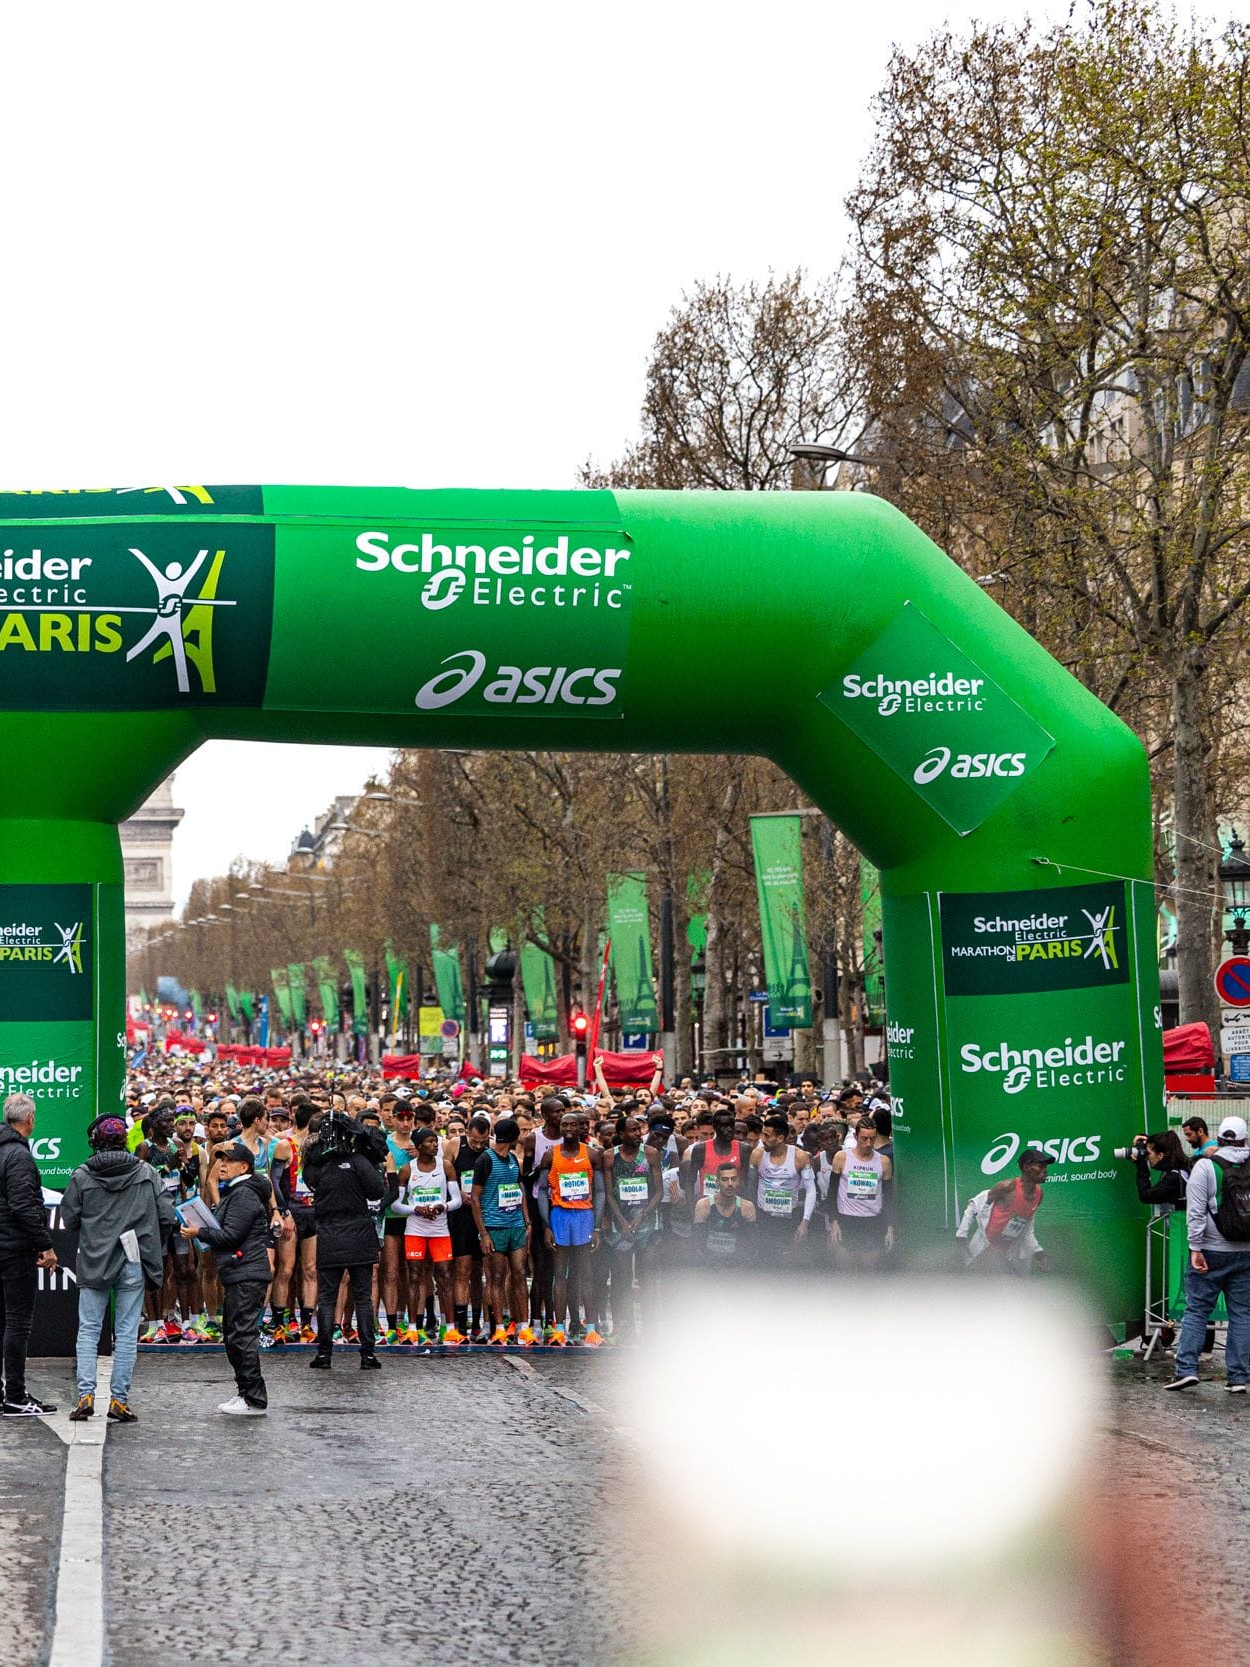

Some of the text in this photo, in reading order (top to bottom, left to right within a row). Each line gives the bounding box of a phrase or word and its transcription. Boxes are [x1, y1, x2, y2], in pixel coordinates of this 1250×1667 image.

[355, 531, 631, 577] Schneider
[843, 672, 984, 697] Schneider
[905, 697, 983, 713] Electric
[973, 913, 1068, 933] Schneider
[0, 936, 41, 945] Electric
[1015, 929, 1068, 942] Electric
[0, 947, 53, 961] PARIS
[951, 945, 1016, 957] MARATHON
[1016, 940, 1083, 961] PARIS
[960, 1036, 1125, 1073] Schneider
[1036, 1067, 1124, 1088] Electric
[8, 1084, 79, 1098] Electric
[56, 1166, 74, 1176] body
[1070, 1171, 1098, 1181] sound
[1098, 1169, 1118, 1180] body
